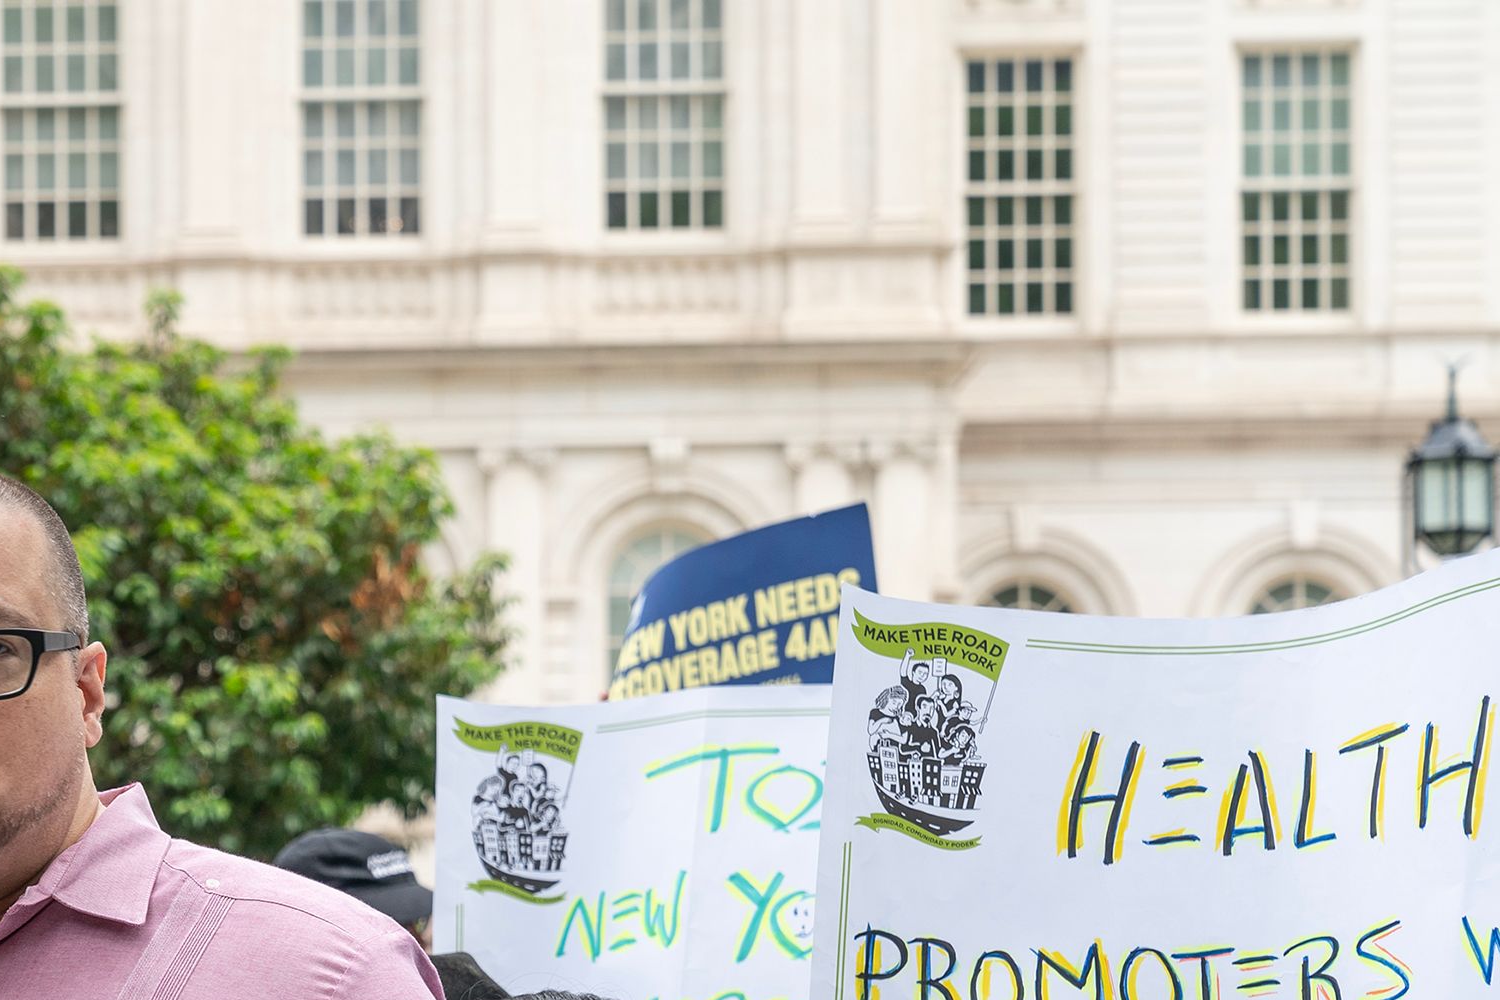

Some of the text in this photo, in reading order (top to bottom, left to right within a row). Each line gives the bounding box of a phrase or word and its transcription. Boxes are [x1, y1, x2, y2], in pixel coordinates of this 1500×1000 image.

[668, 593, 751, 651] YORK
[864, 624, 1003, 658] MAKE THE ROAD
[923, 644, 997, 672] NEW YORK
[464, 725, 579, 746] MAKE THE ROAD
[514, 739, 574, 755] NEW YORK
[1060, 695, 1495, 865] HEALTH
[873, 818, 905, 830] DIGNIDAD,
[906, 826, 944, 847] COMUNIDAD
[555, 869, 687, 963] NEW
